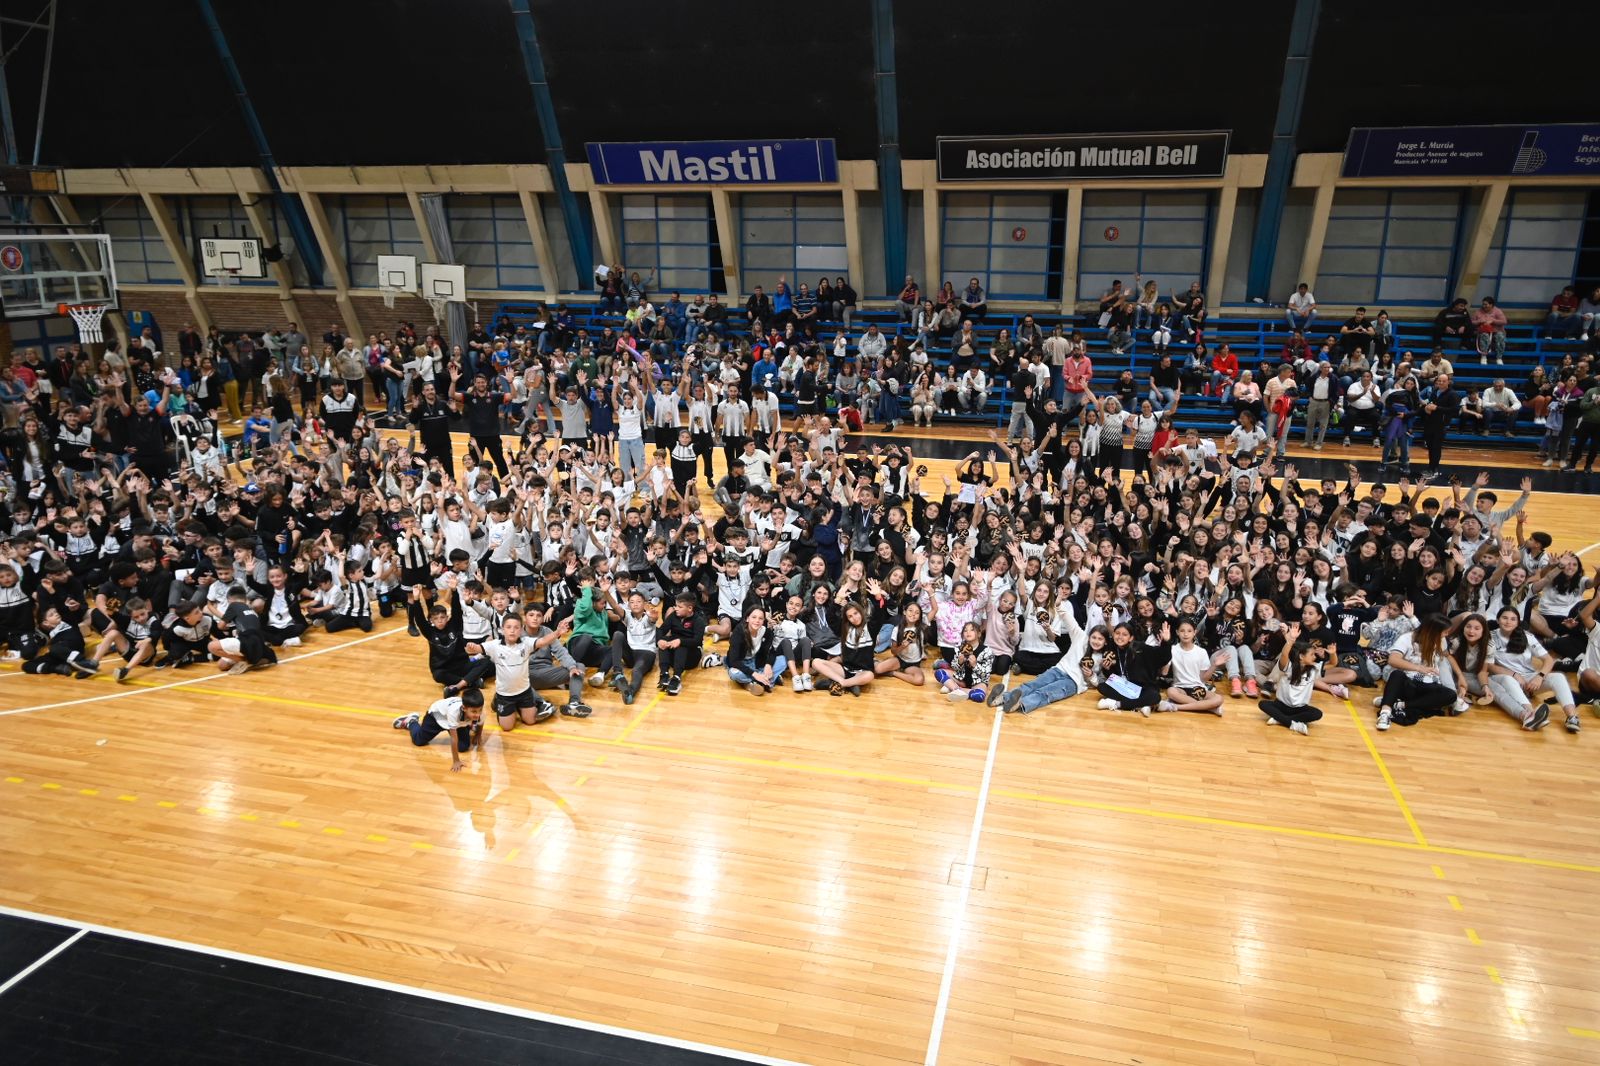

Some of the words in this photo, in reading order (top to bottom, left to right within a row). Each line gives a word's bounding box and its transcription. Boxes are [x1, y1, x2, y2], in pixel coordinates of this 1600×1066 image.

[1397, 141, 1418, 151] Jorge
[965, 147, 1076, 169] Asociación
[1080, 145, 1151, 167] Mutual
[1155, 144, 1198, 166] Bell
